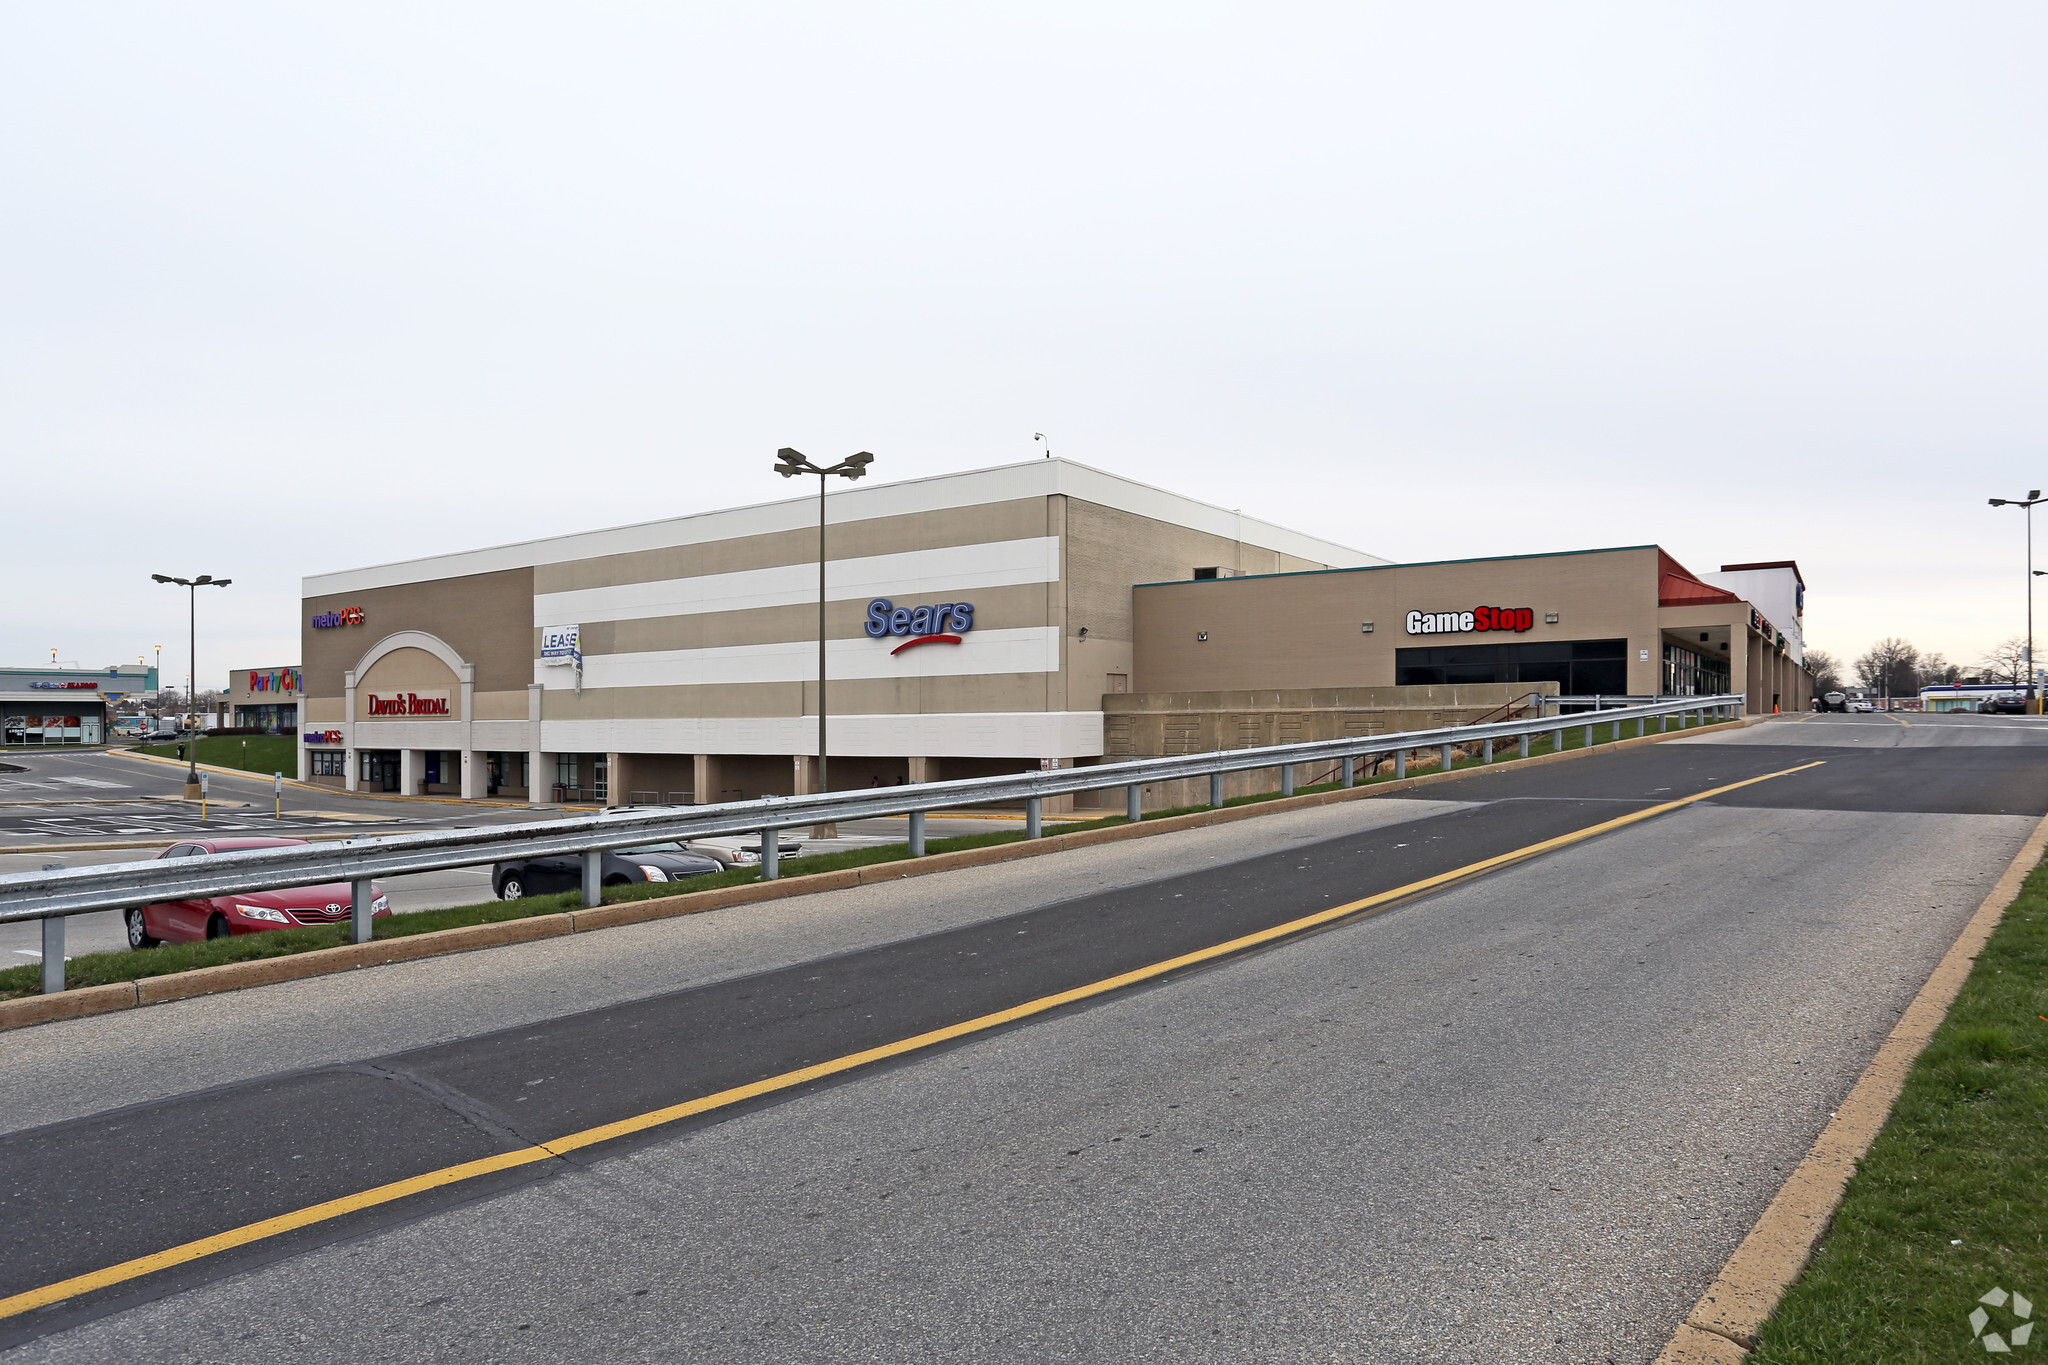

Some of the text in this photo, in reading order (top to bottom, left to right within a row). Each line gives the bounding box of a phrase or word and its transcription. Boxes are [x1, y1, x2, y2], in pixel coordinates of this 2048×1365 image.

[312, 606, 362, 628] metroPCS
[864, 598, 974, 638] Sears
[1406, 605, 1533, 634] GameStop
[543, 633, 577, 648] LEASE
[407, 693, 449, 714] BRIDAL
[303, 730, 341, 744] metroPCS
